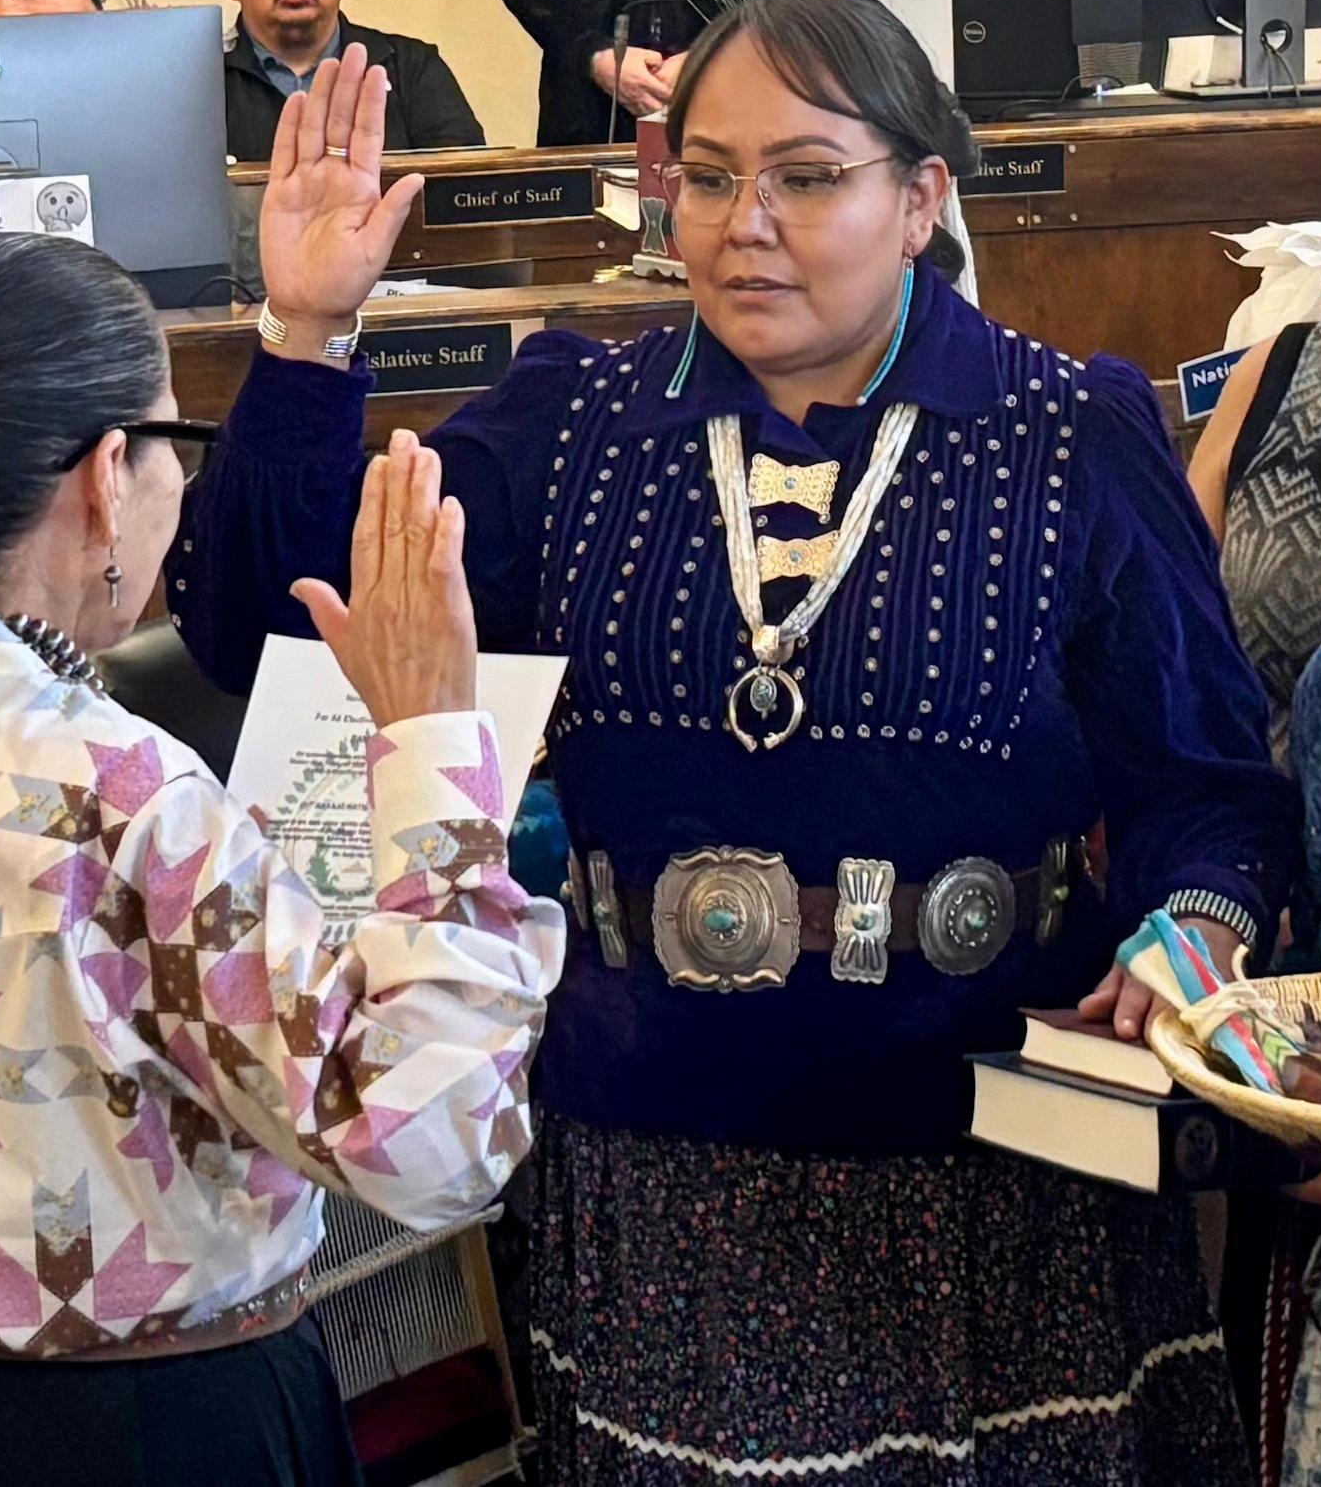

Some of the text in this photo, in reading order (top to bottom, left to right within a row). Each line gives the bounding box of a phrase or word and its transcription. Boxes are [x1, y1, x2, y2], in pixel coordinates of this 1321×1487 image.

[1008, 159, 1045, 176] Staff
[454, 187, 563, 208] Chief of Staff
[439, 344, 487, 365] Staff
